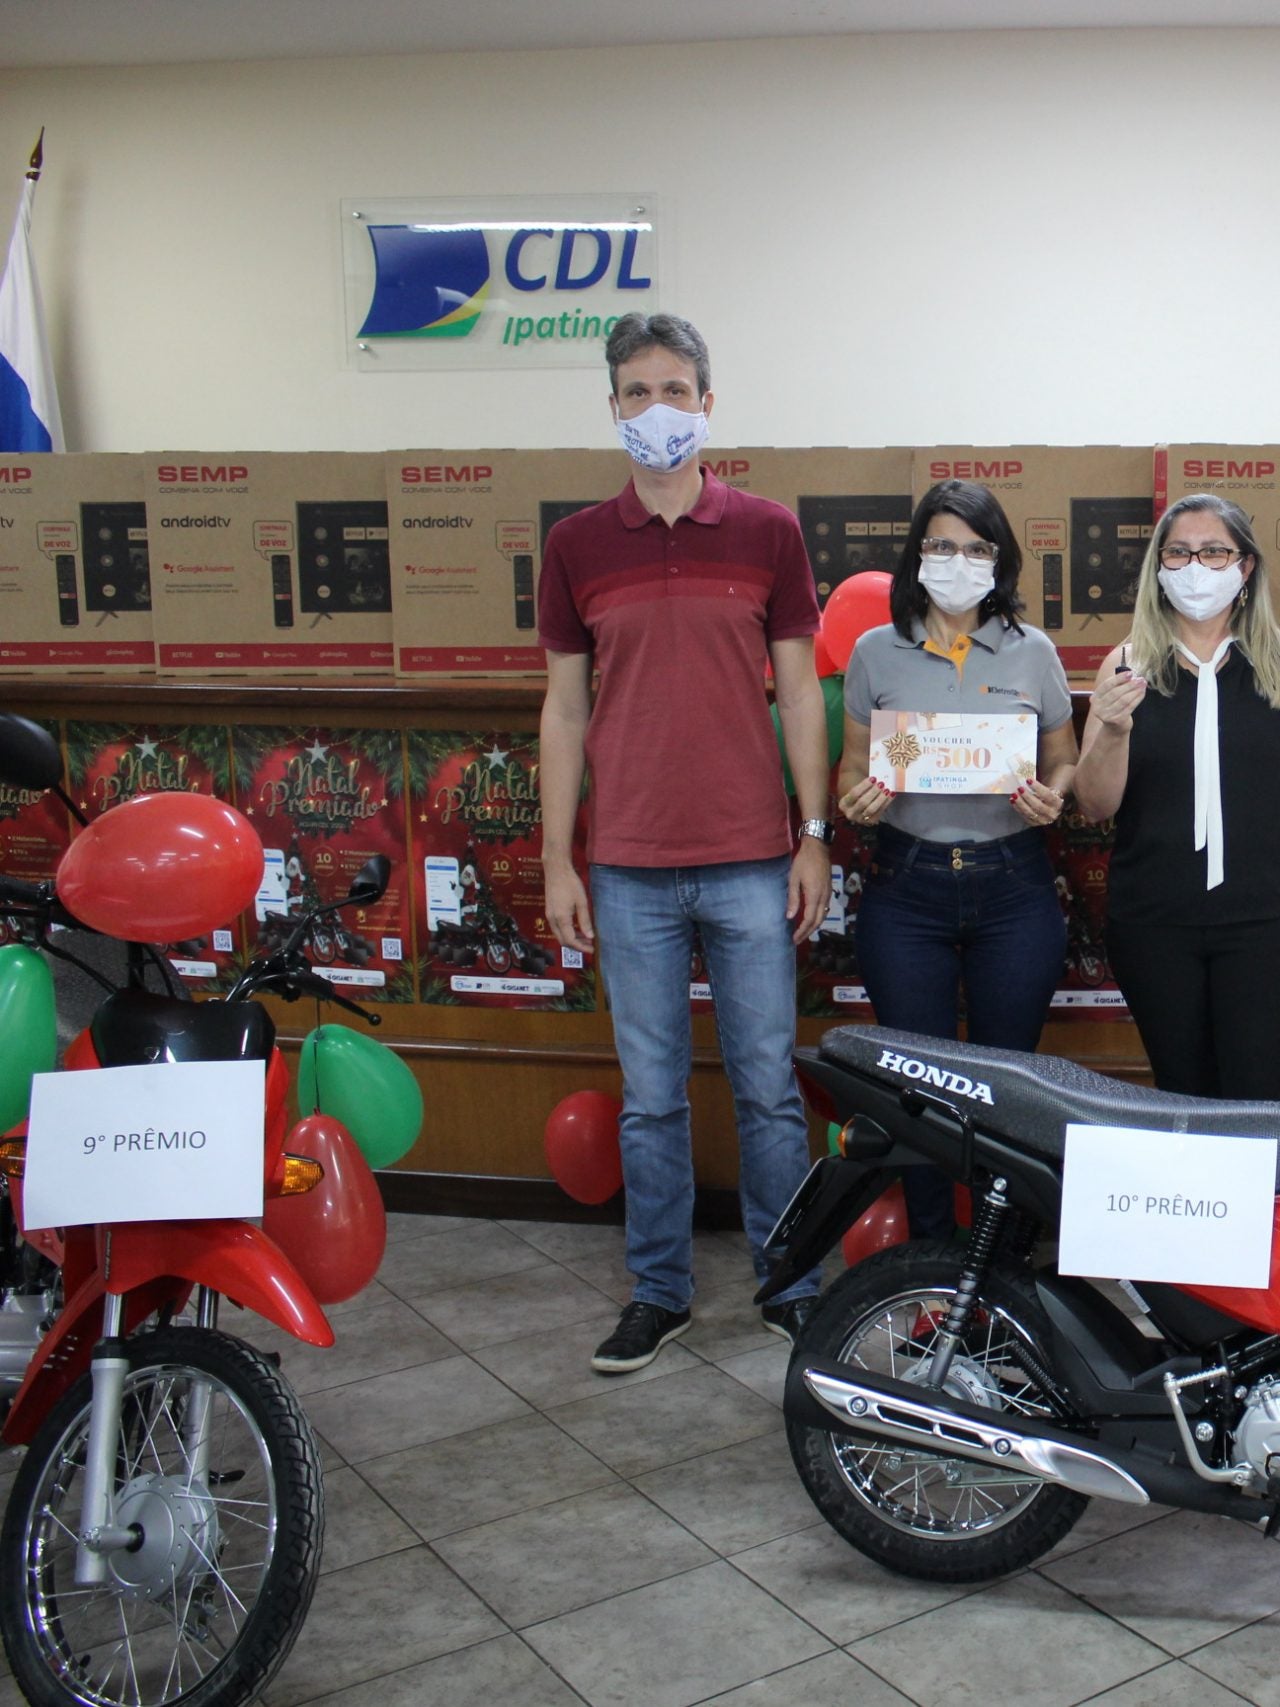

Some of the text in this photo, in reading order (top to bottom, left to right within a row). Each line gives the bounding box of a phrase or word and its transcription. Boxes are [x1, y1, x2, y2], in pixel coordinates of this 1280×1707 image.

[505, 228, 651, 291] CDL
[503, 309, 614, 344] Ipatin
[158, 466, 248, 482] SEMP
[401, 466, 492, 483] SEMP
[702, 460, 750, 477] MP
[930, 461, 1023, 479] SEMP
[1183, 460, 1275, 478] SEMP
[922, 736, 973, 746] VOUCHER
[936, 747, 992, 769] 500
[119, 751, 191, 792] Natal
[287, 756, 361, 796] Natal
[260, 780, 381, 821] Premiado
[316, 853, 331, 863] 10
[493, 860, 509, 871] 10
[1087, 869, 1105, 881] 10
[877, 1050, 995, 1106] HONDA
[113, 1128, 207, 1153] PRÊMIO
[1145, 1193, 1229, 1220] PRÊMIO
